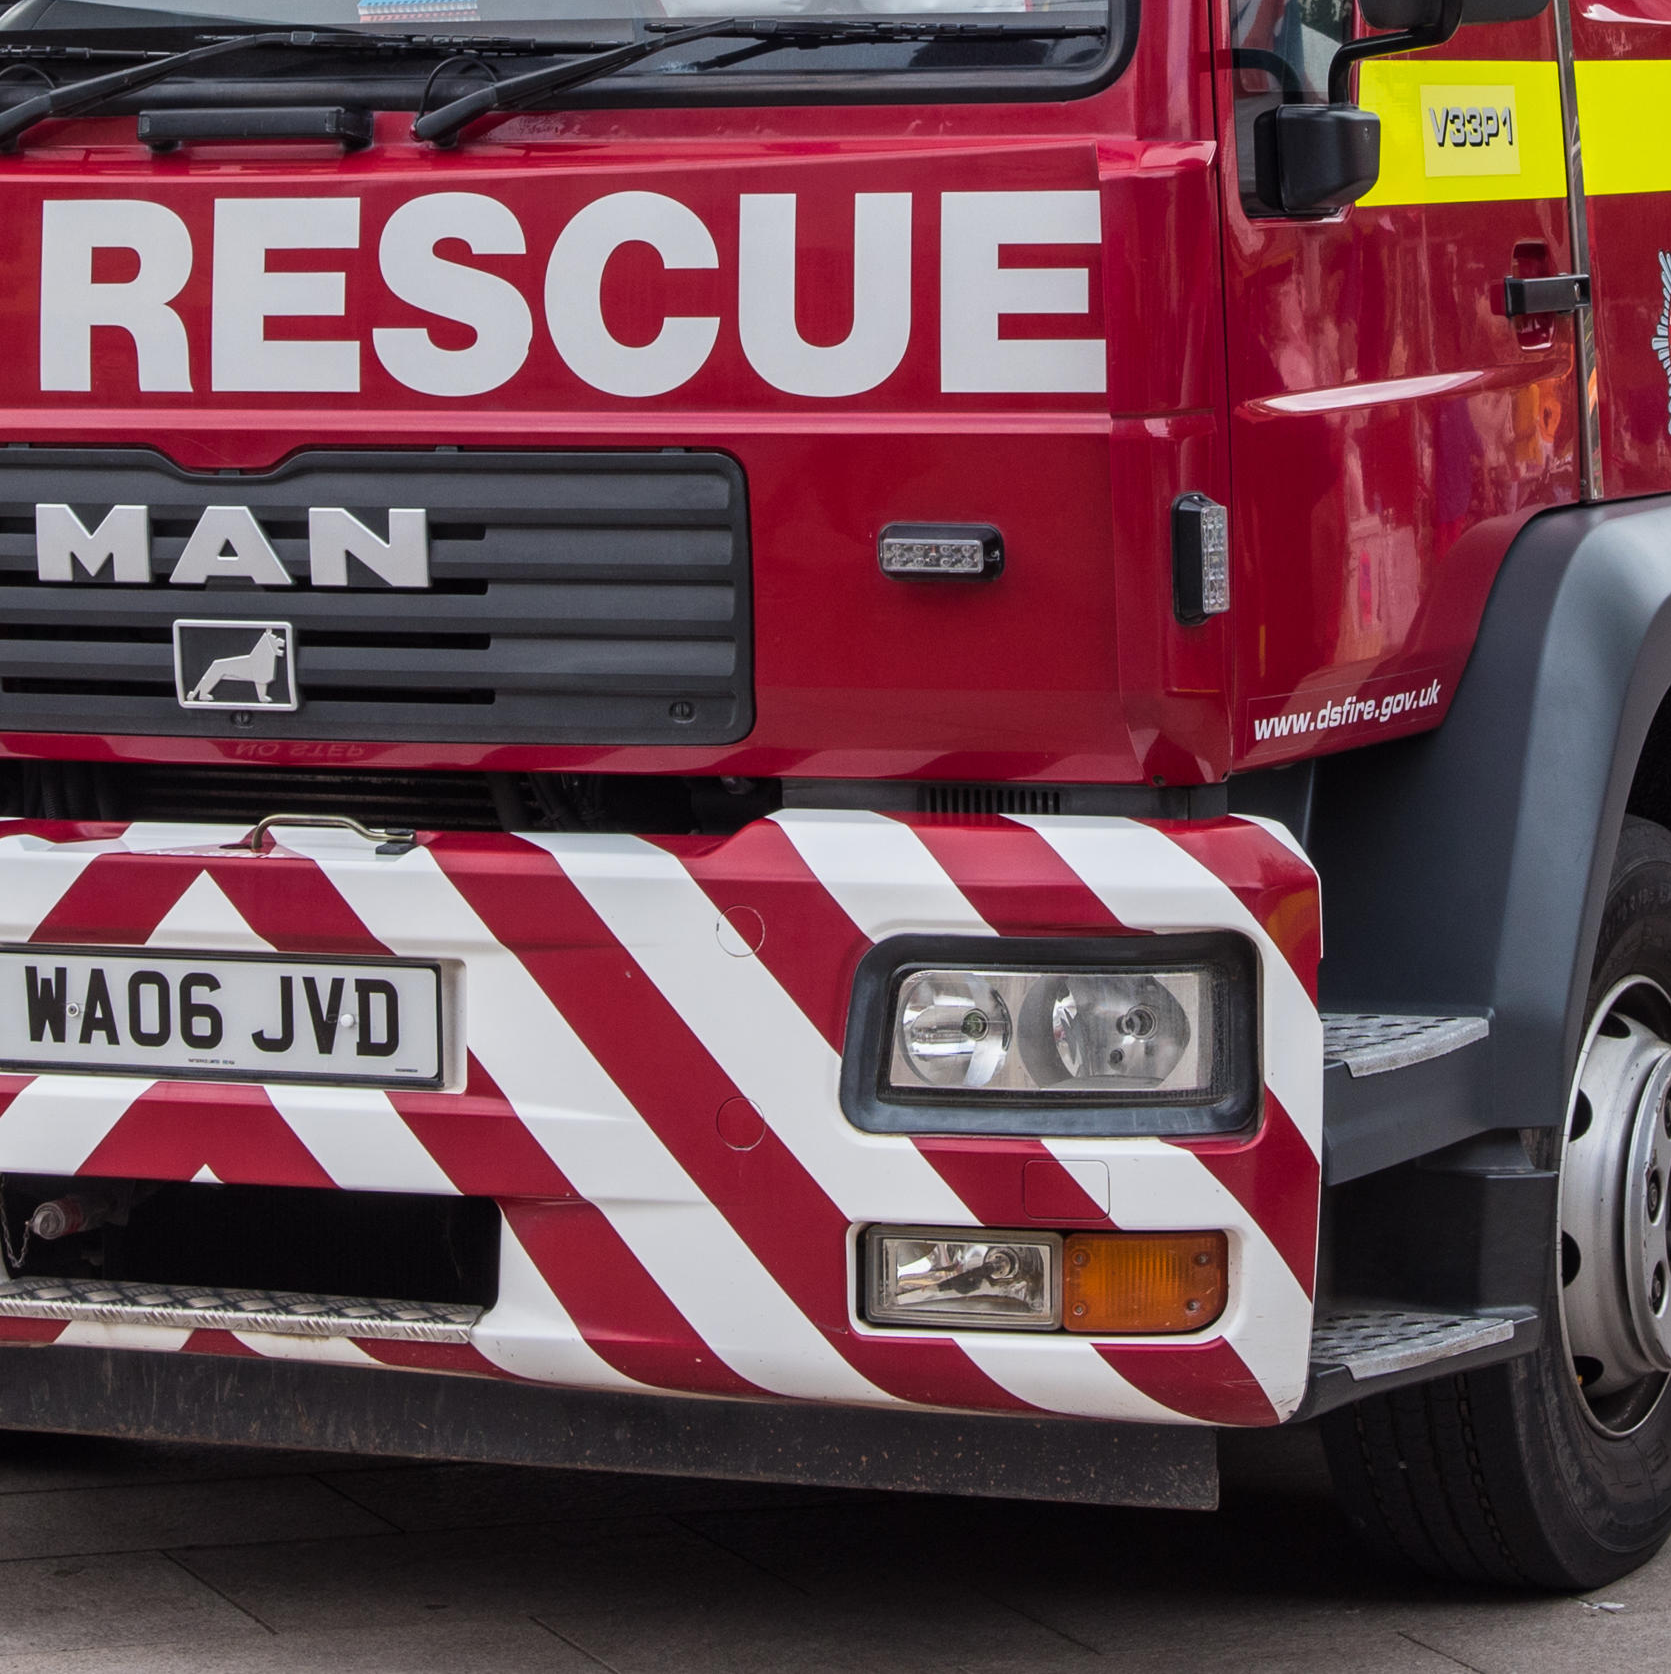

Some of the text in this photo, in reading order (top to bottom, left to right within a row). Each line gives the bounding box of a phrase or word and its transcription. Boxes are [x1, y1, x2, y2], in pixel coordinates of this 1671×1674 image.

[1429, 107, 1513, 147] V33P1
[40, 190, 1106, 396] RESCUE
[34, 502, 433, 588] MAN
[1254, 679, 1442, 741] www.dsfire.gov.uk
[25, 965, 399, 1057] WA06 JVD
